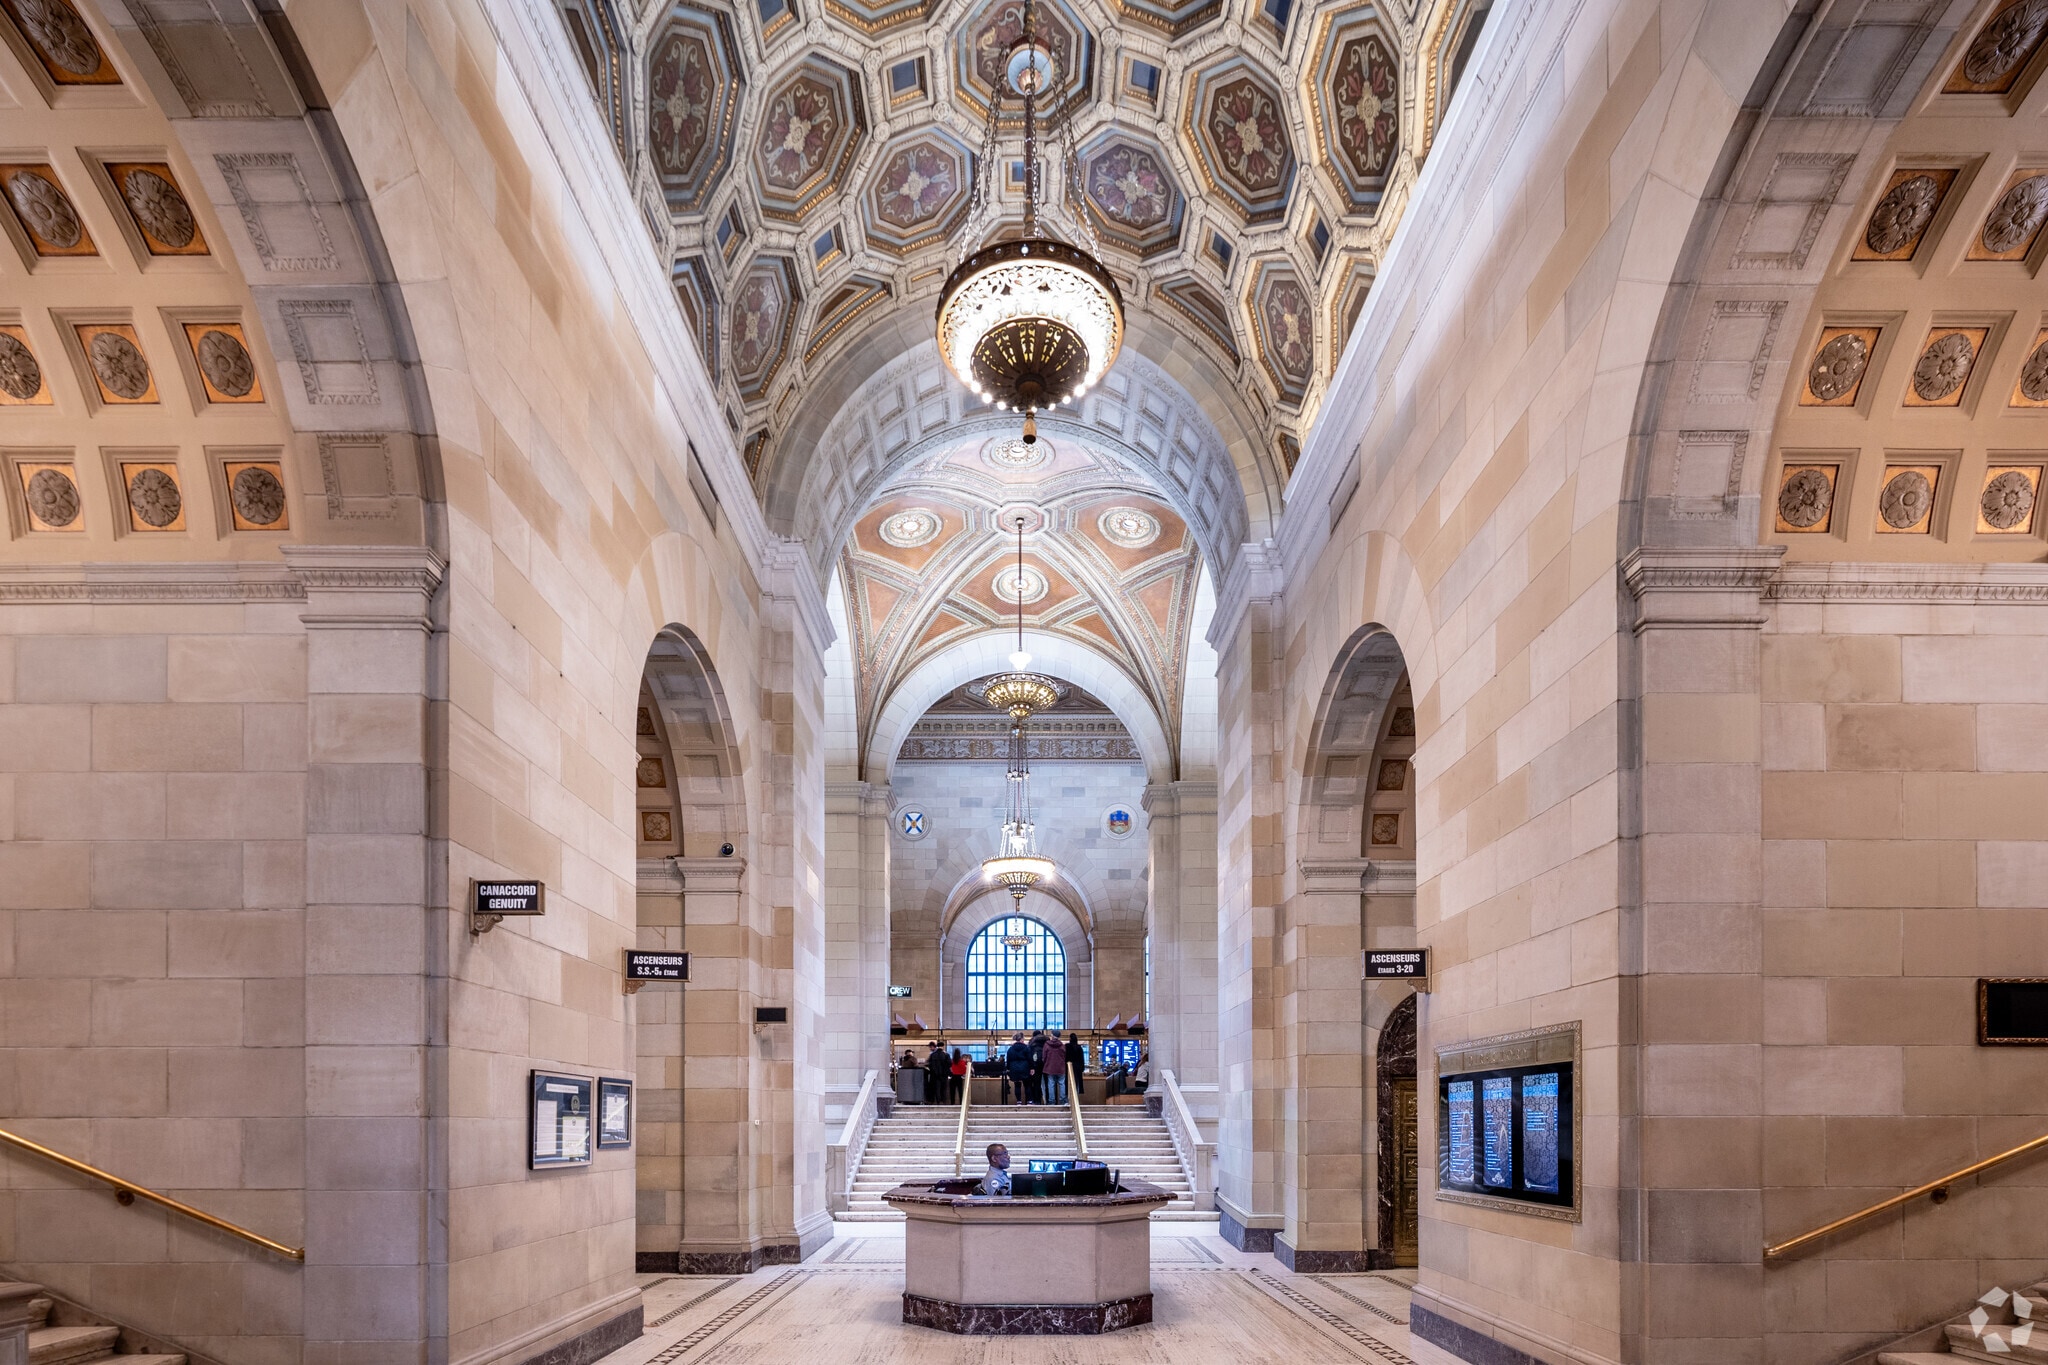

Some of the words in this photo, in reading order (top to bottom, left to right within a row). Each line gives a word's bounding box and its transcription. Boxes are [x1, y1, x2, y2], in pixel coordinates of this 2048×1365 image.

[480, 885, 536, 896] CANACCORD
[489, 898, 527, 909] GENUITY
[633, 955, 683, 966] ASCENSEURS
[1371, 954, 1420, 963] ASCENSEURS
[1396, 965, 1413, 973] 3-20
